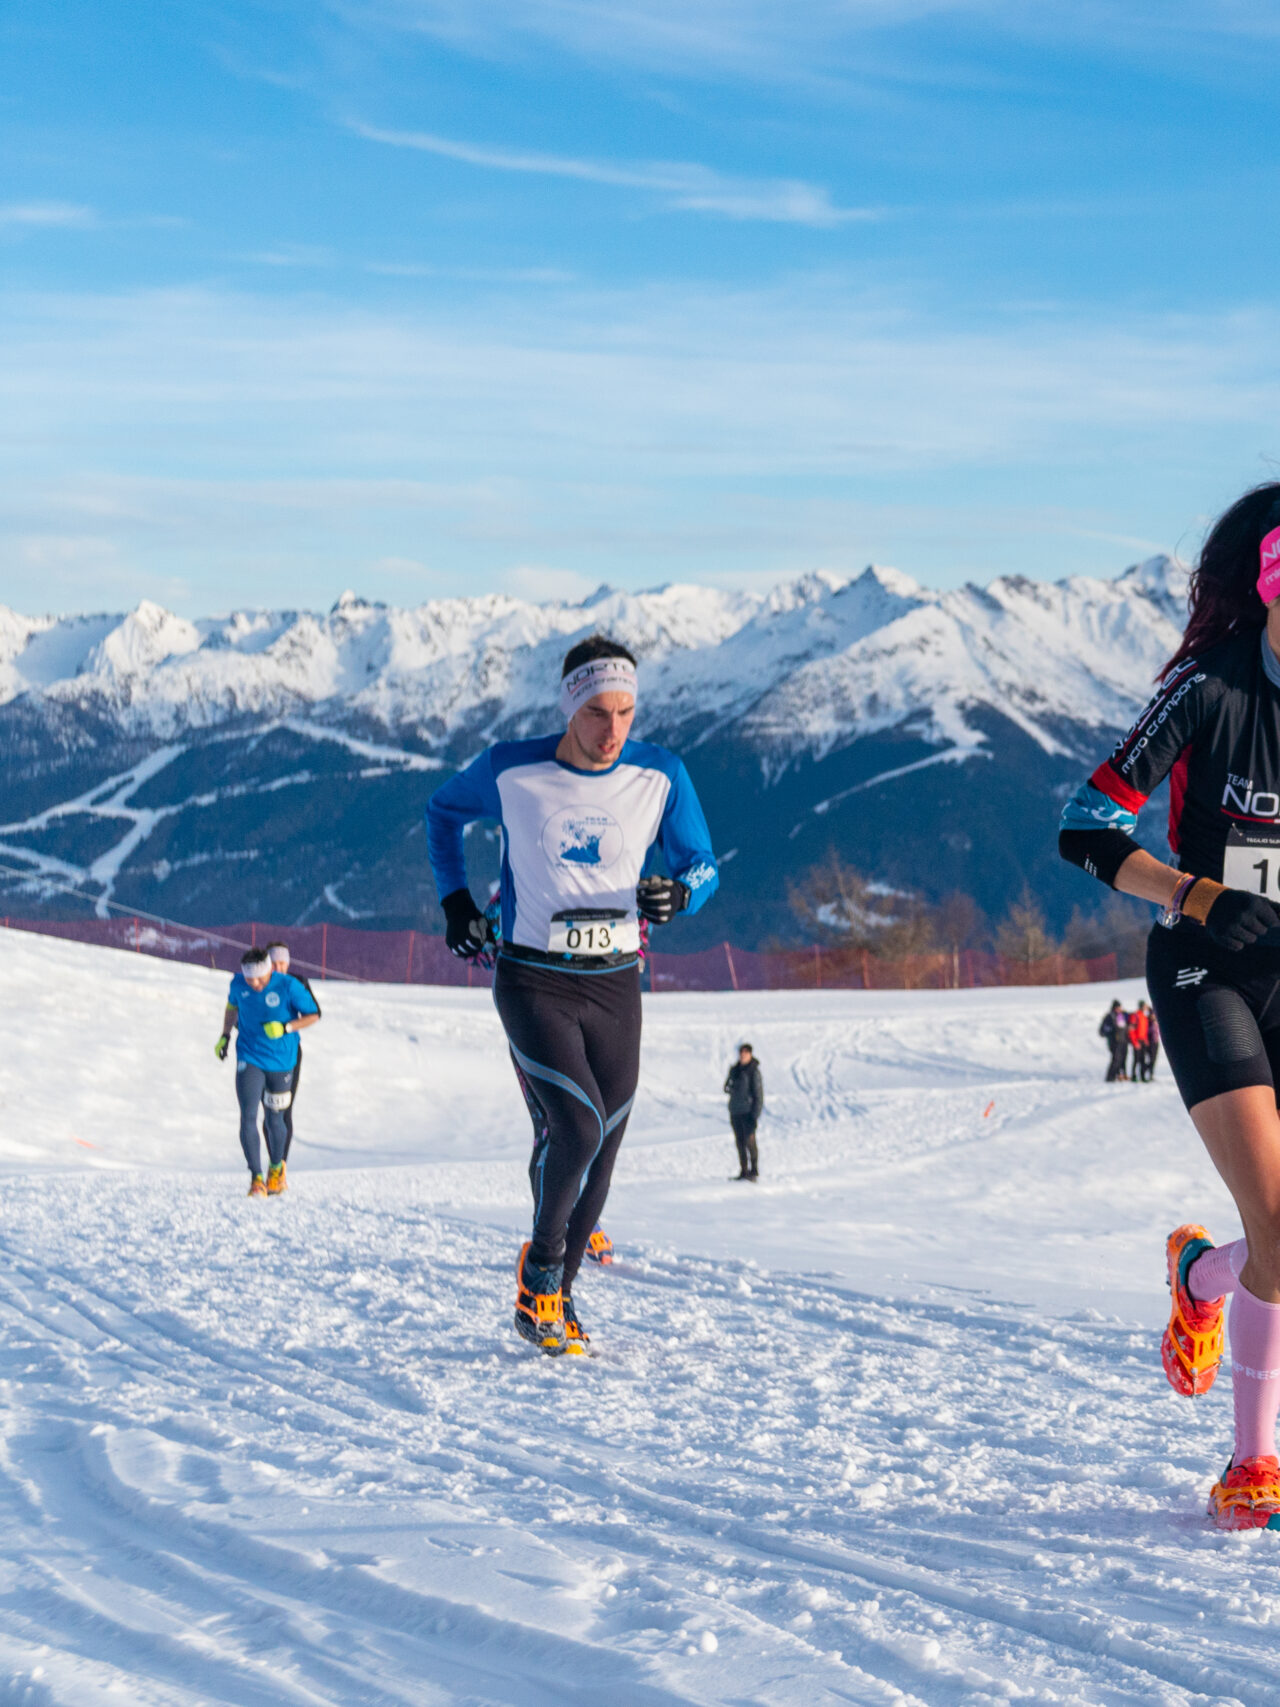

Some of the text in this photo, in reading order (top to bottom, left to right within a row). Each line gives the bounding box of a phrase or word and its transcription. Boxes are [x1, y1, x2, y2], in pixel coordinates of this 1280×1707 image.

[1121, 673, 1207, 774] micro crampons
[1227, 773, 1253, 790] TEAM
[566, 927, 611, 949] 013
